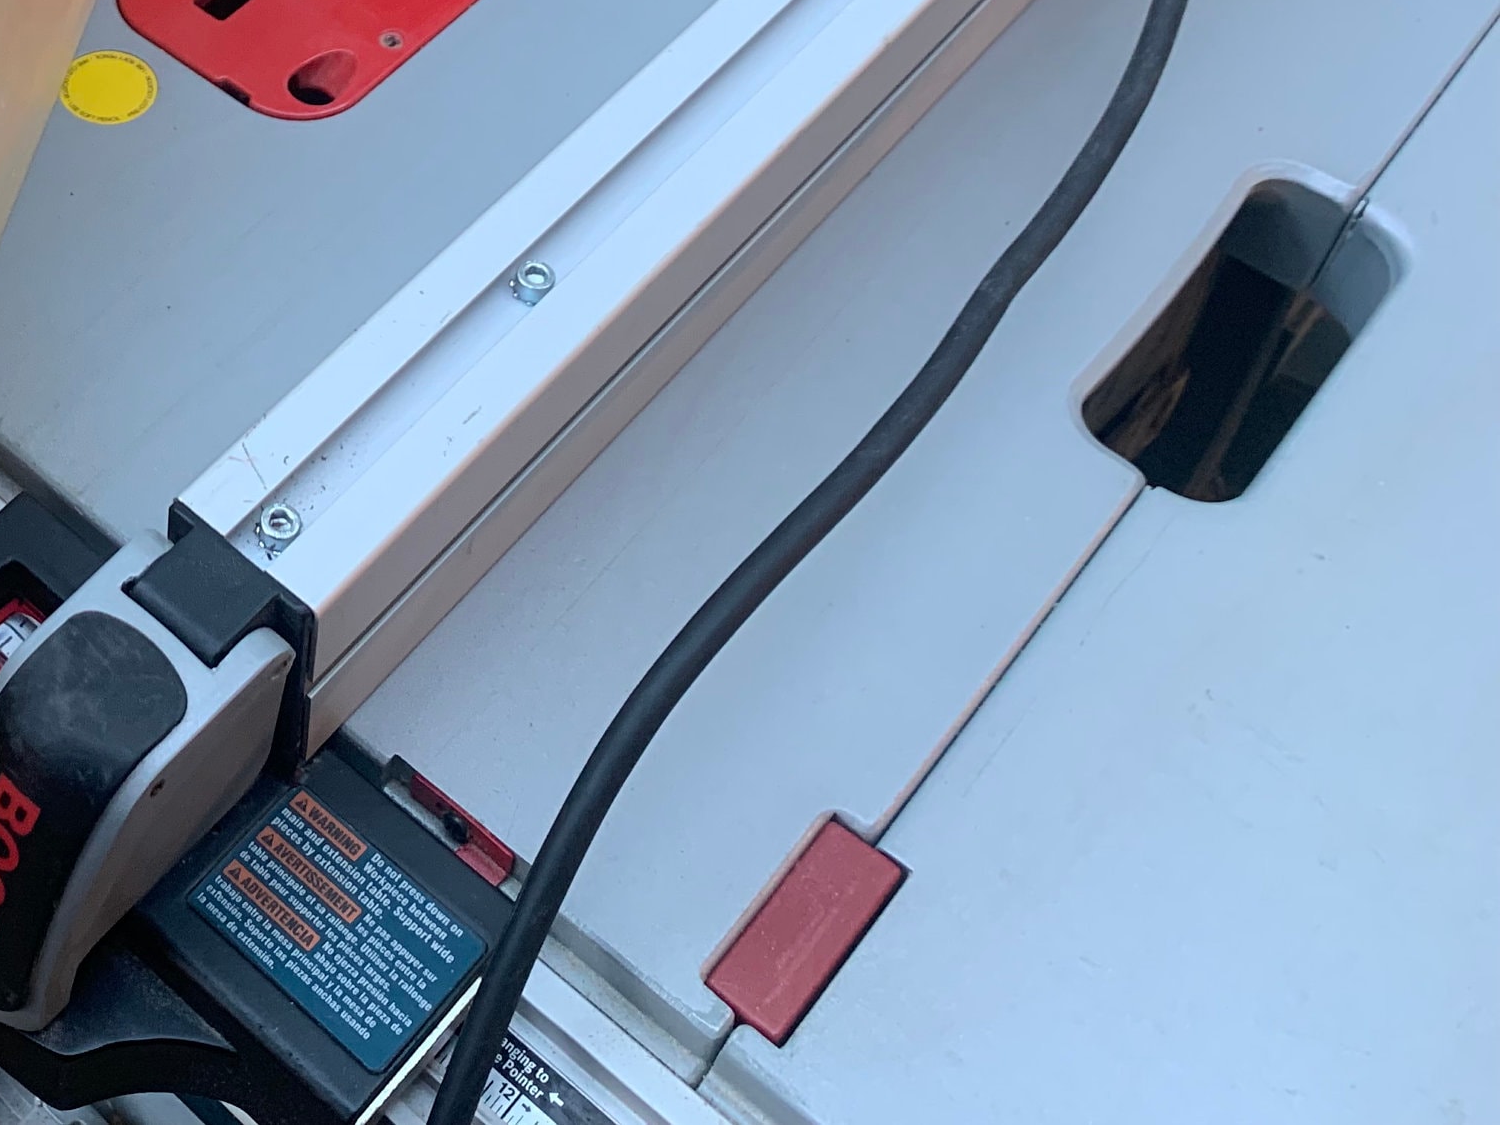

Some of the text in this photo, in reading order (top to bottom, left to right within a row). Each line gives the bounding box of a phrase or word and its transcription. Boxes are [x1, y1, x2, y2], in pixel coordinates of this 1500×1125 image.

[270, 816, 386, 919] pieces by extension table.
[307, 806, 362, 855] WARNING
[239, 877, 315, 946] ADVERTENCIA
[272, 843, 357, 919] AVERTISSEMENT
[281, 807, 455, 964] main and extension table. Support wide
[360, 862, 448, 940] Workpiece between
[370, 854, 463, 937] Do not press down on
[197, 892, 277, 969] la mesa de extensión.
[212, 875, 377, 1027] trabajo entre la mesa principal y la mesa de
[239, 850, 393, 993] de table pour supporter les pièces larges.
[246, 841, 433, 1012] table principale et sa rallonge. Utiliser la rallonge
[354, 922, 428, 989] les pièces entre la
[362, 914, 437, 983] Ne pas appuyer sur
[205, 883, 371, 1039] extensión. Soporte las piezas anchas usando
[312, 950, 403, 1035] abajo sobre la pieza de
[321, 942, 413, 1027] No ejerza presión hacia
[499, 1082, 516, 1101] 12
[501, 1037, 537, 1074] anging
[535, 1067, 549, 1083] to
[502, 1058, 544, 1099] Pointer
